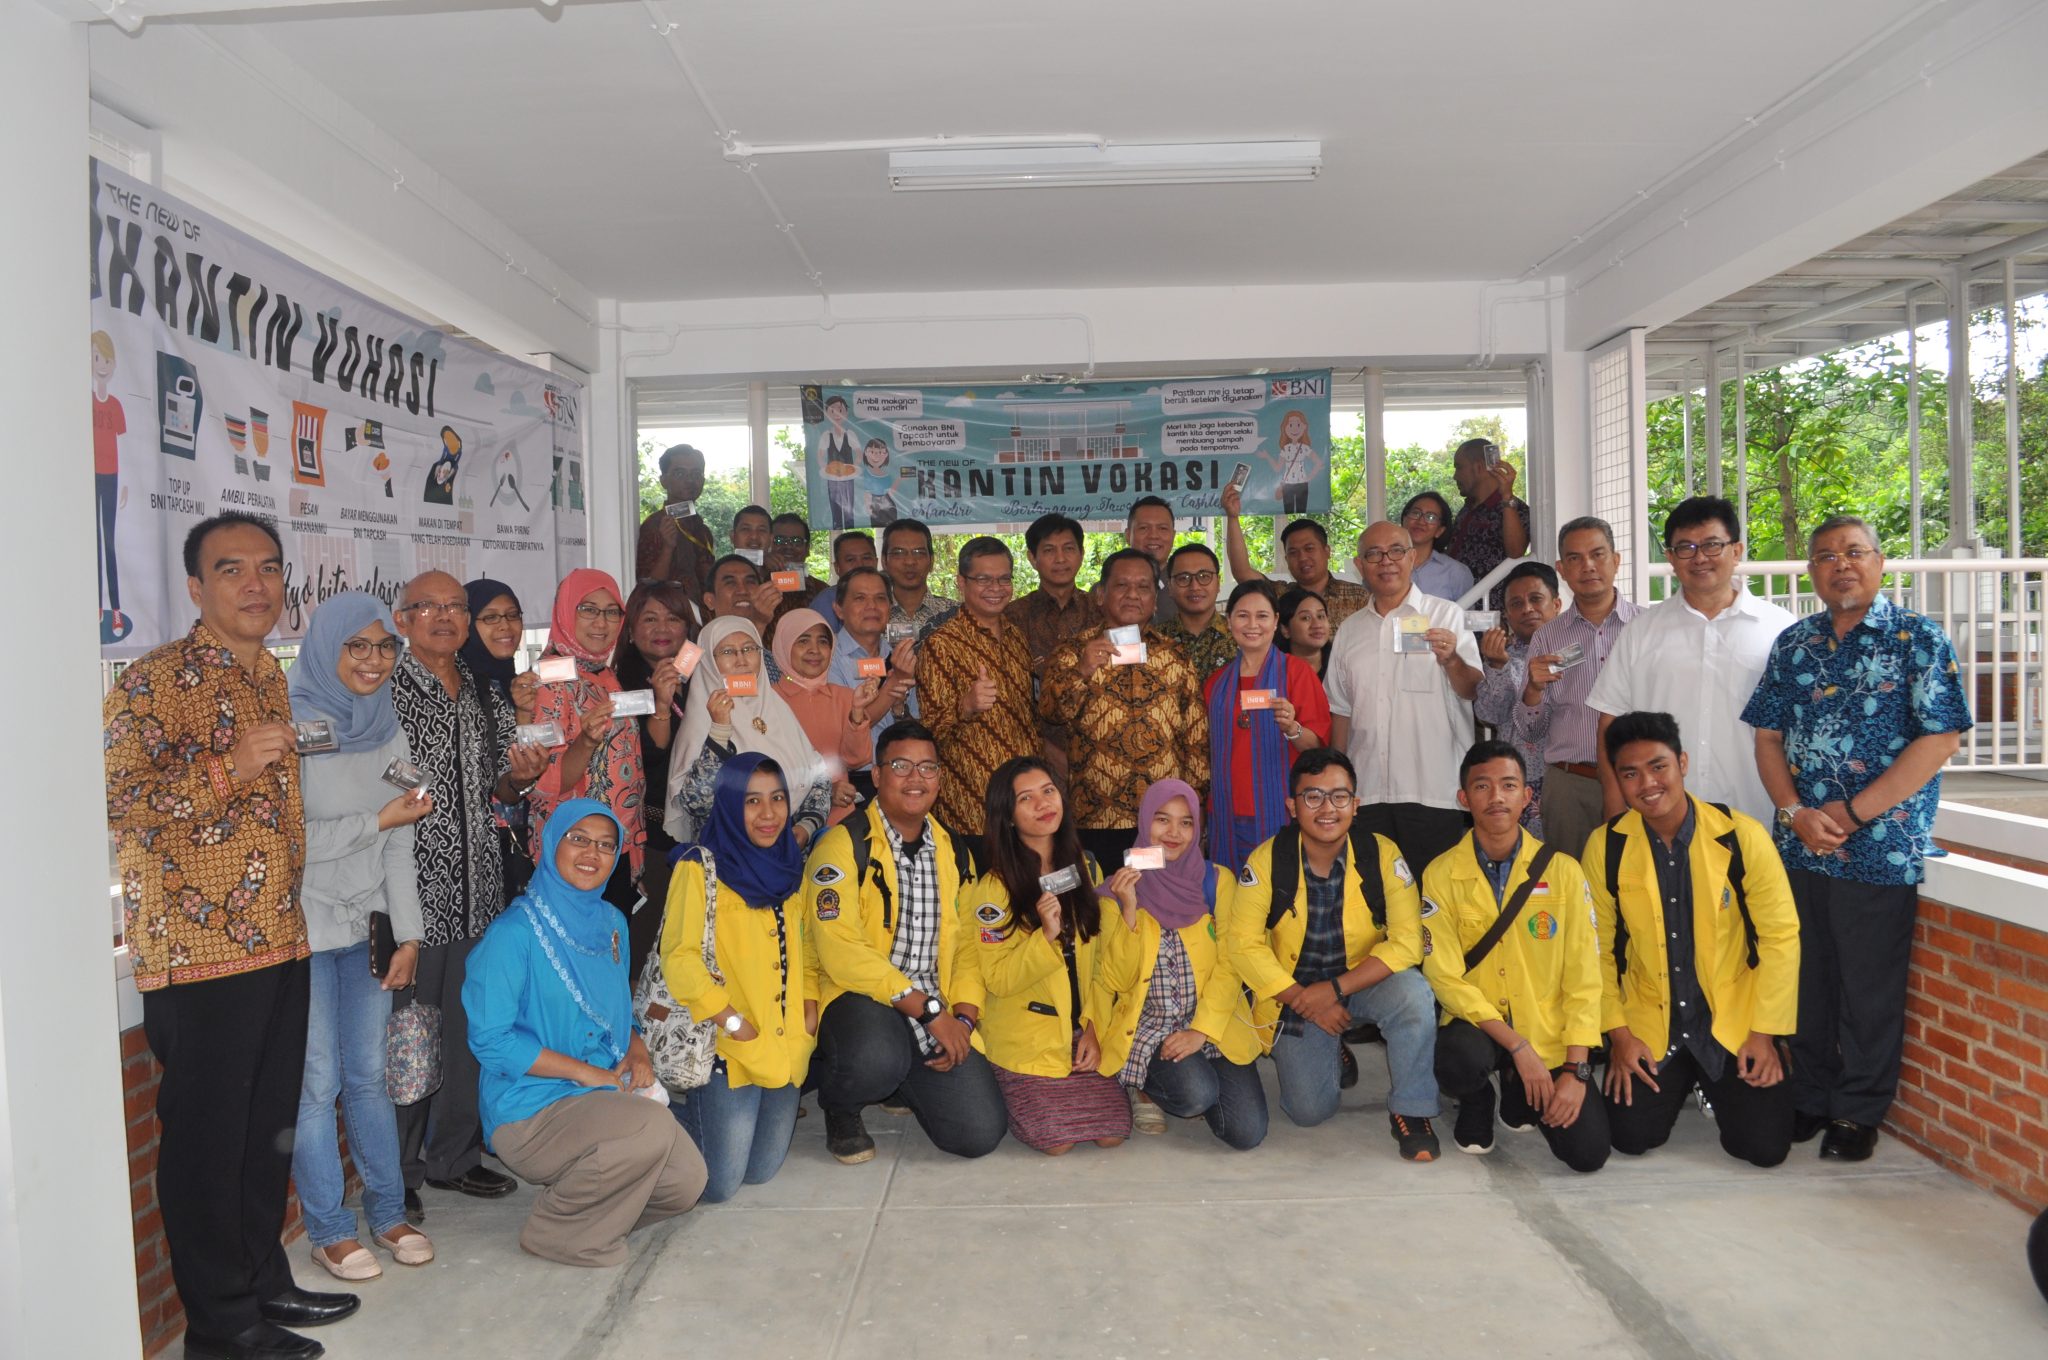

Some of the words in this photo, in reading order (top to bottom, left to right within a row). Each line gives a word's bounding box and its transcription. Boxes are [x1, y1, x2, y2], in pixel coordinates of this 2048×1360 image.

[105, 182, 141, 215] THE
[183, 219, 201, 241] OF
[107, 213, 303, 372] KANTIN
[312, 312, 437, 417] VOKASI
[1172, 389, 1206, 397] Pastikan
[1208, 387, 1230, 397] meja
[1233, 387, 1255, 396] tetap
[1291, 379, 1325, 396] BNI
[856, 397, 878, 405] Ambil
[881, 397, 918, 405] makanan
[1164, 396, 1188, 404] bersih
[1190, 395, 1220, 403] setelah
[1222, 393, 1263, 403] digunakan
[901, 424, 938, 432] Gunakan
[1199, 422, 1215, 430] jaga
[898, 432, 934, 440] Tapcash
[902, 439, 956, 448] pembayaran
[918, 459, 936, 467] THE
[938, 459, 959, 467] NEW
[962, 459, 976, 467] OF
[168, 477, 181, 494] TOP
[182, 480, 191, 496] UP
[917, 466, 1065, 499] KANTIN
[1081, 460, 1219, 494] VOKASI
[150, 493, 166, 511] BNI
[167, 495, 194, 514] TAPCASH
[195, 500, 205, 516] MU
[220, 488, 245, 505] AMBIL
[247, 492, 276, 510] PERALATAN
[300, 502, 319, 516] PESAN
[340, 507, 357, 521] BAYAR
[357, 510, 398, 525] MENGGUNAKAN
[418, 517, 436, 529] MAKAN
[437, 518, 444, 529] DI
[443, 519, 463, 531] TEMPAT
[496, 524, 514, 535] BAWA
[514, 525, 531, 536] PIRING
[353, 527, 362, 539] BNI
[363, 527, 387, 541] TAPCASH
[410, 533, 425, 545] YANG
[425, 534, 440, 545] TELAH
